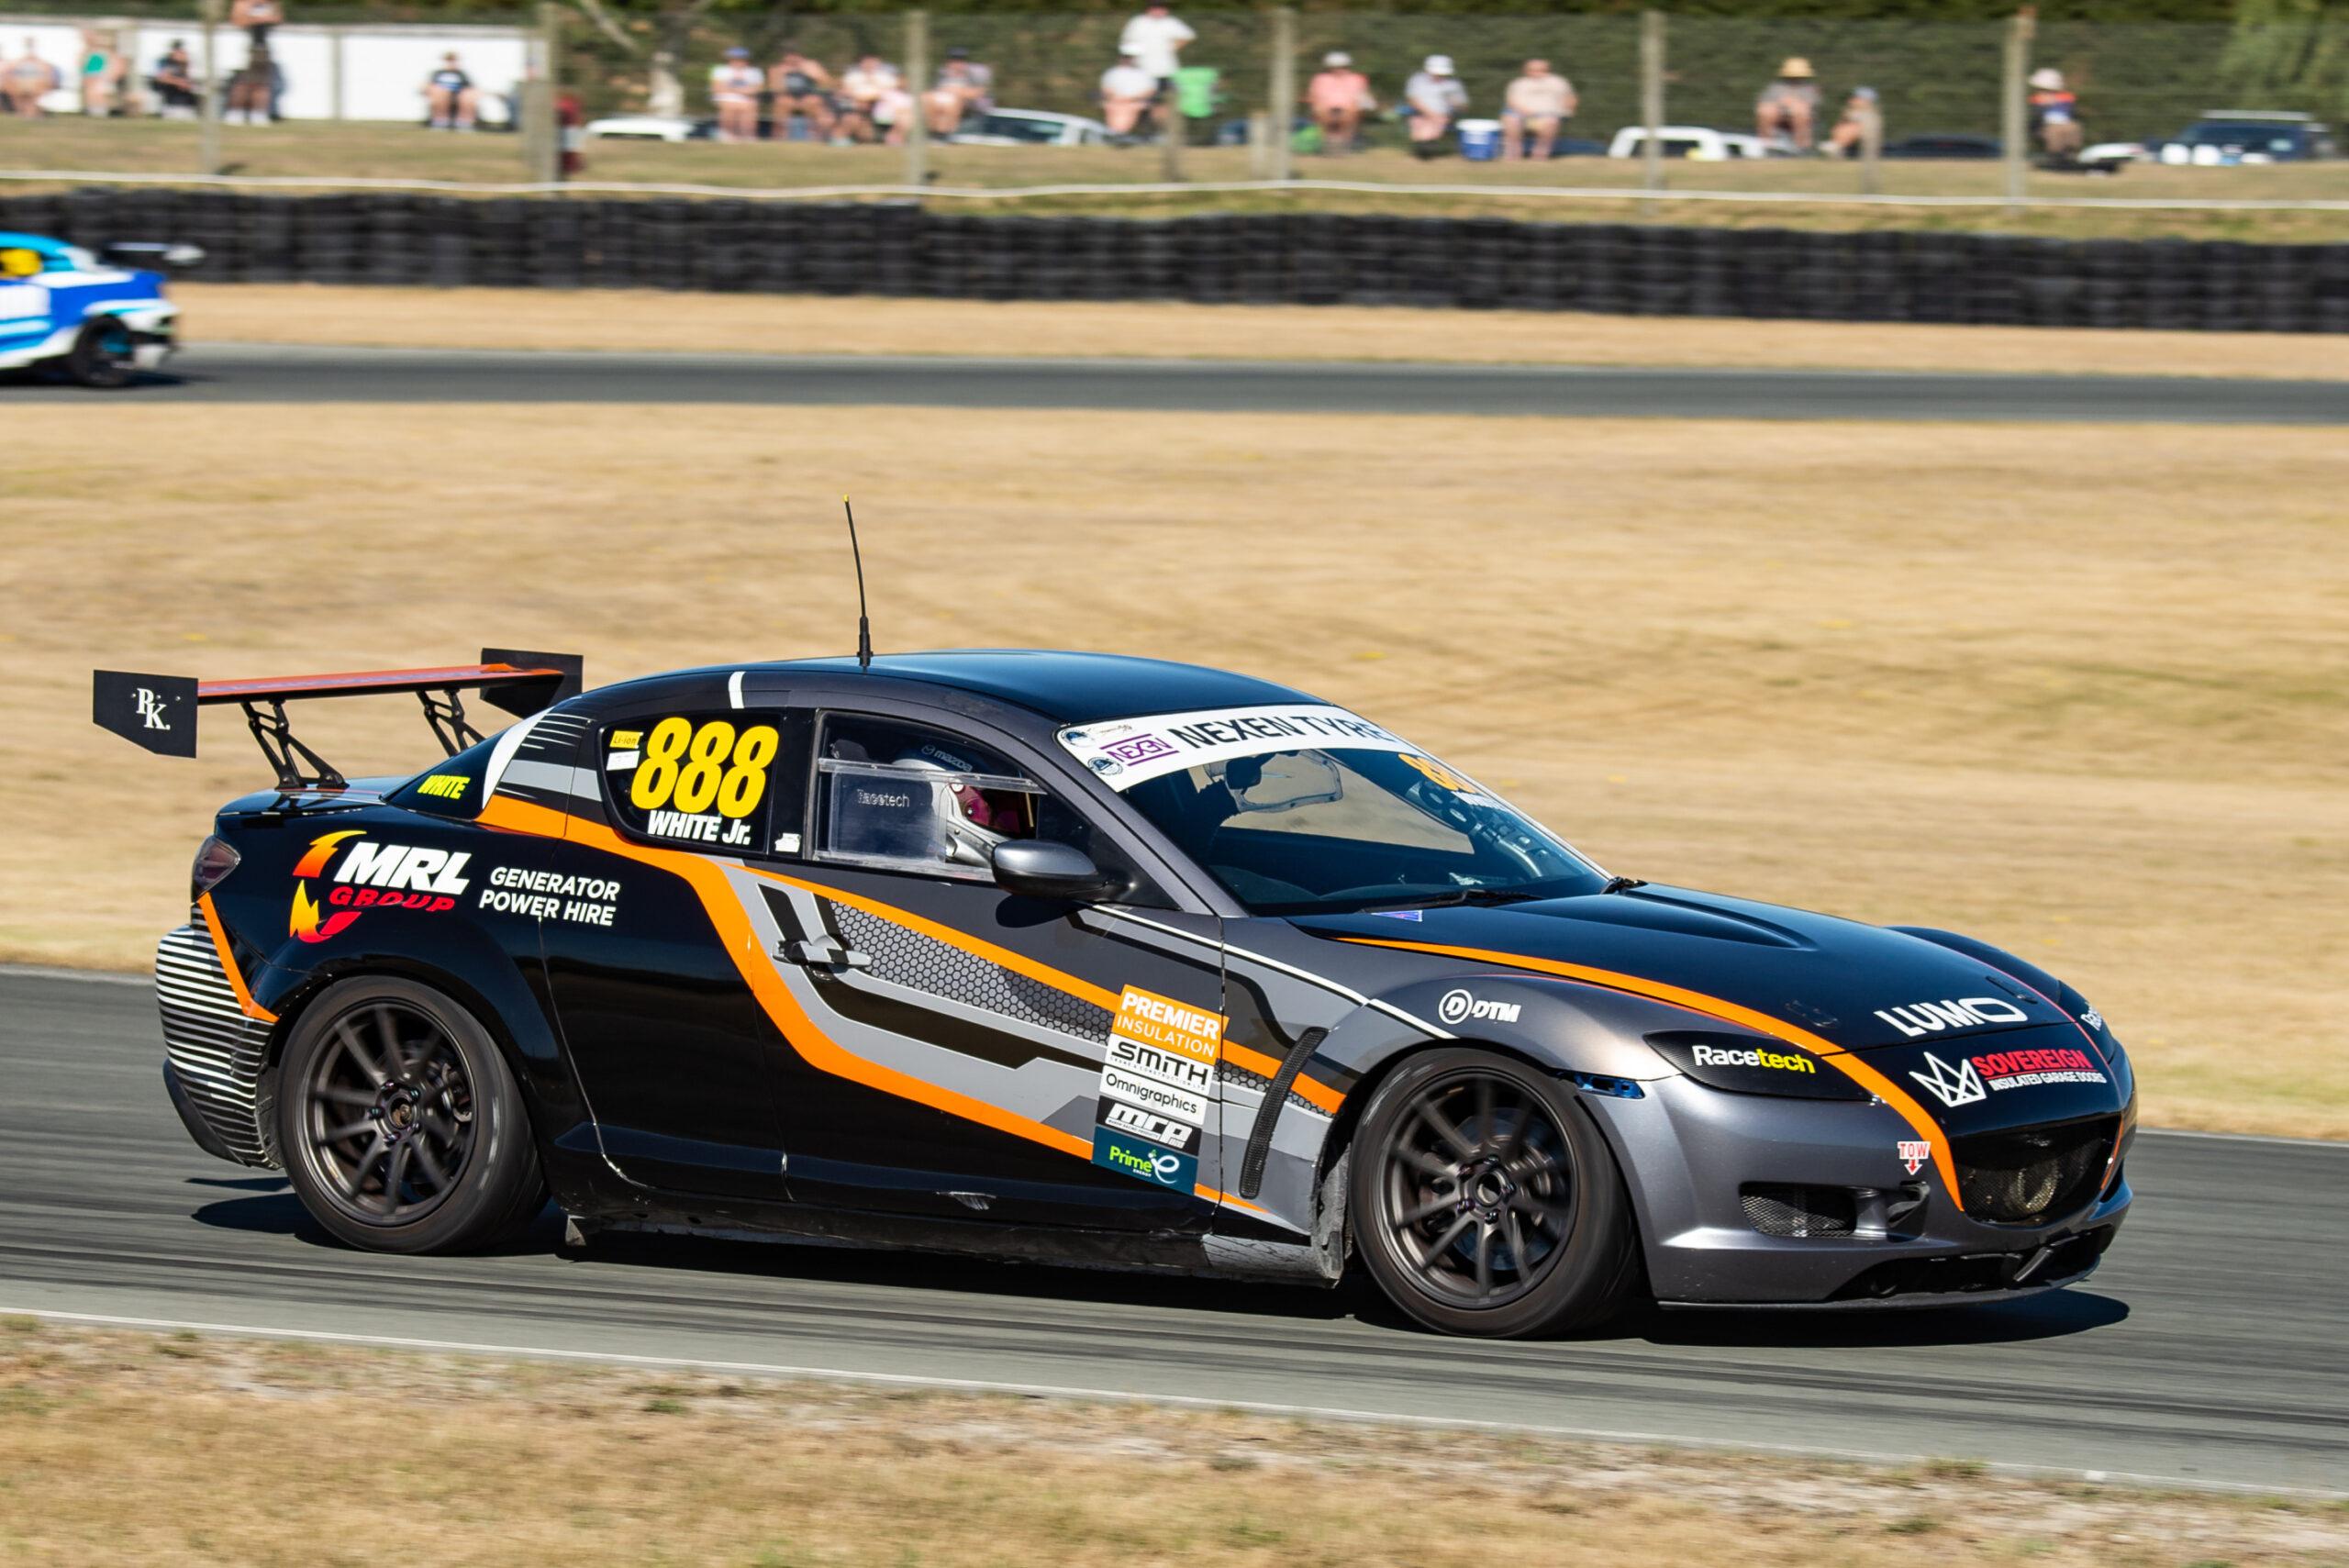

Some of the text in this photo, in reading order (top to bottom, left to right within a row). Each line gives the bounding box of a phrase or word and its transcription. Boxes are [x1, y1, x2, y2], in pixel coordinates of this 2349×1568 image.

[1166, 716, 1293, 749] NEXEN
[1107, 737, 1174, 763] NEXEN
[630, 717, 779, 818] 888
[417, 774, 471, 799] WHITE
[647, 809, 751, 845] WHITE Jr.
[333, 841, 473, 895] MRL
[489, 866, 621, 901] GENERATOR
[328, 886, 456, 912] GROUP
[478, 890, 617, 927] POWER HIRE
[1121, 991, 1219, 1040] PREMIER
[1471, 999, 1521, 1023] DTM
[1874, 997, 2029, 1038] LUMO
[1117, 1015, 1216, 1058] INSULATION
[1692, 1044, 1816, 1073] Racetech
[1971, 1049, 2094, 1076] SOVEREIGN
[1106, 1073, 1197, 1114] Omnigraphics
[1987, 1073, 2043, 1091] INSULATED
[1109, 1145, 1152, 1173] Prime
[1899, 1143, 1928, 1157] TOW
